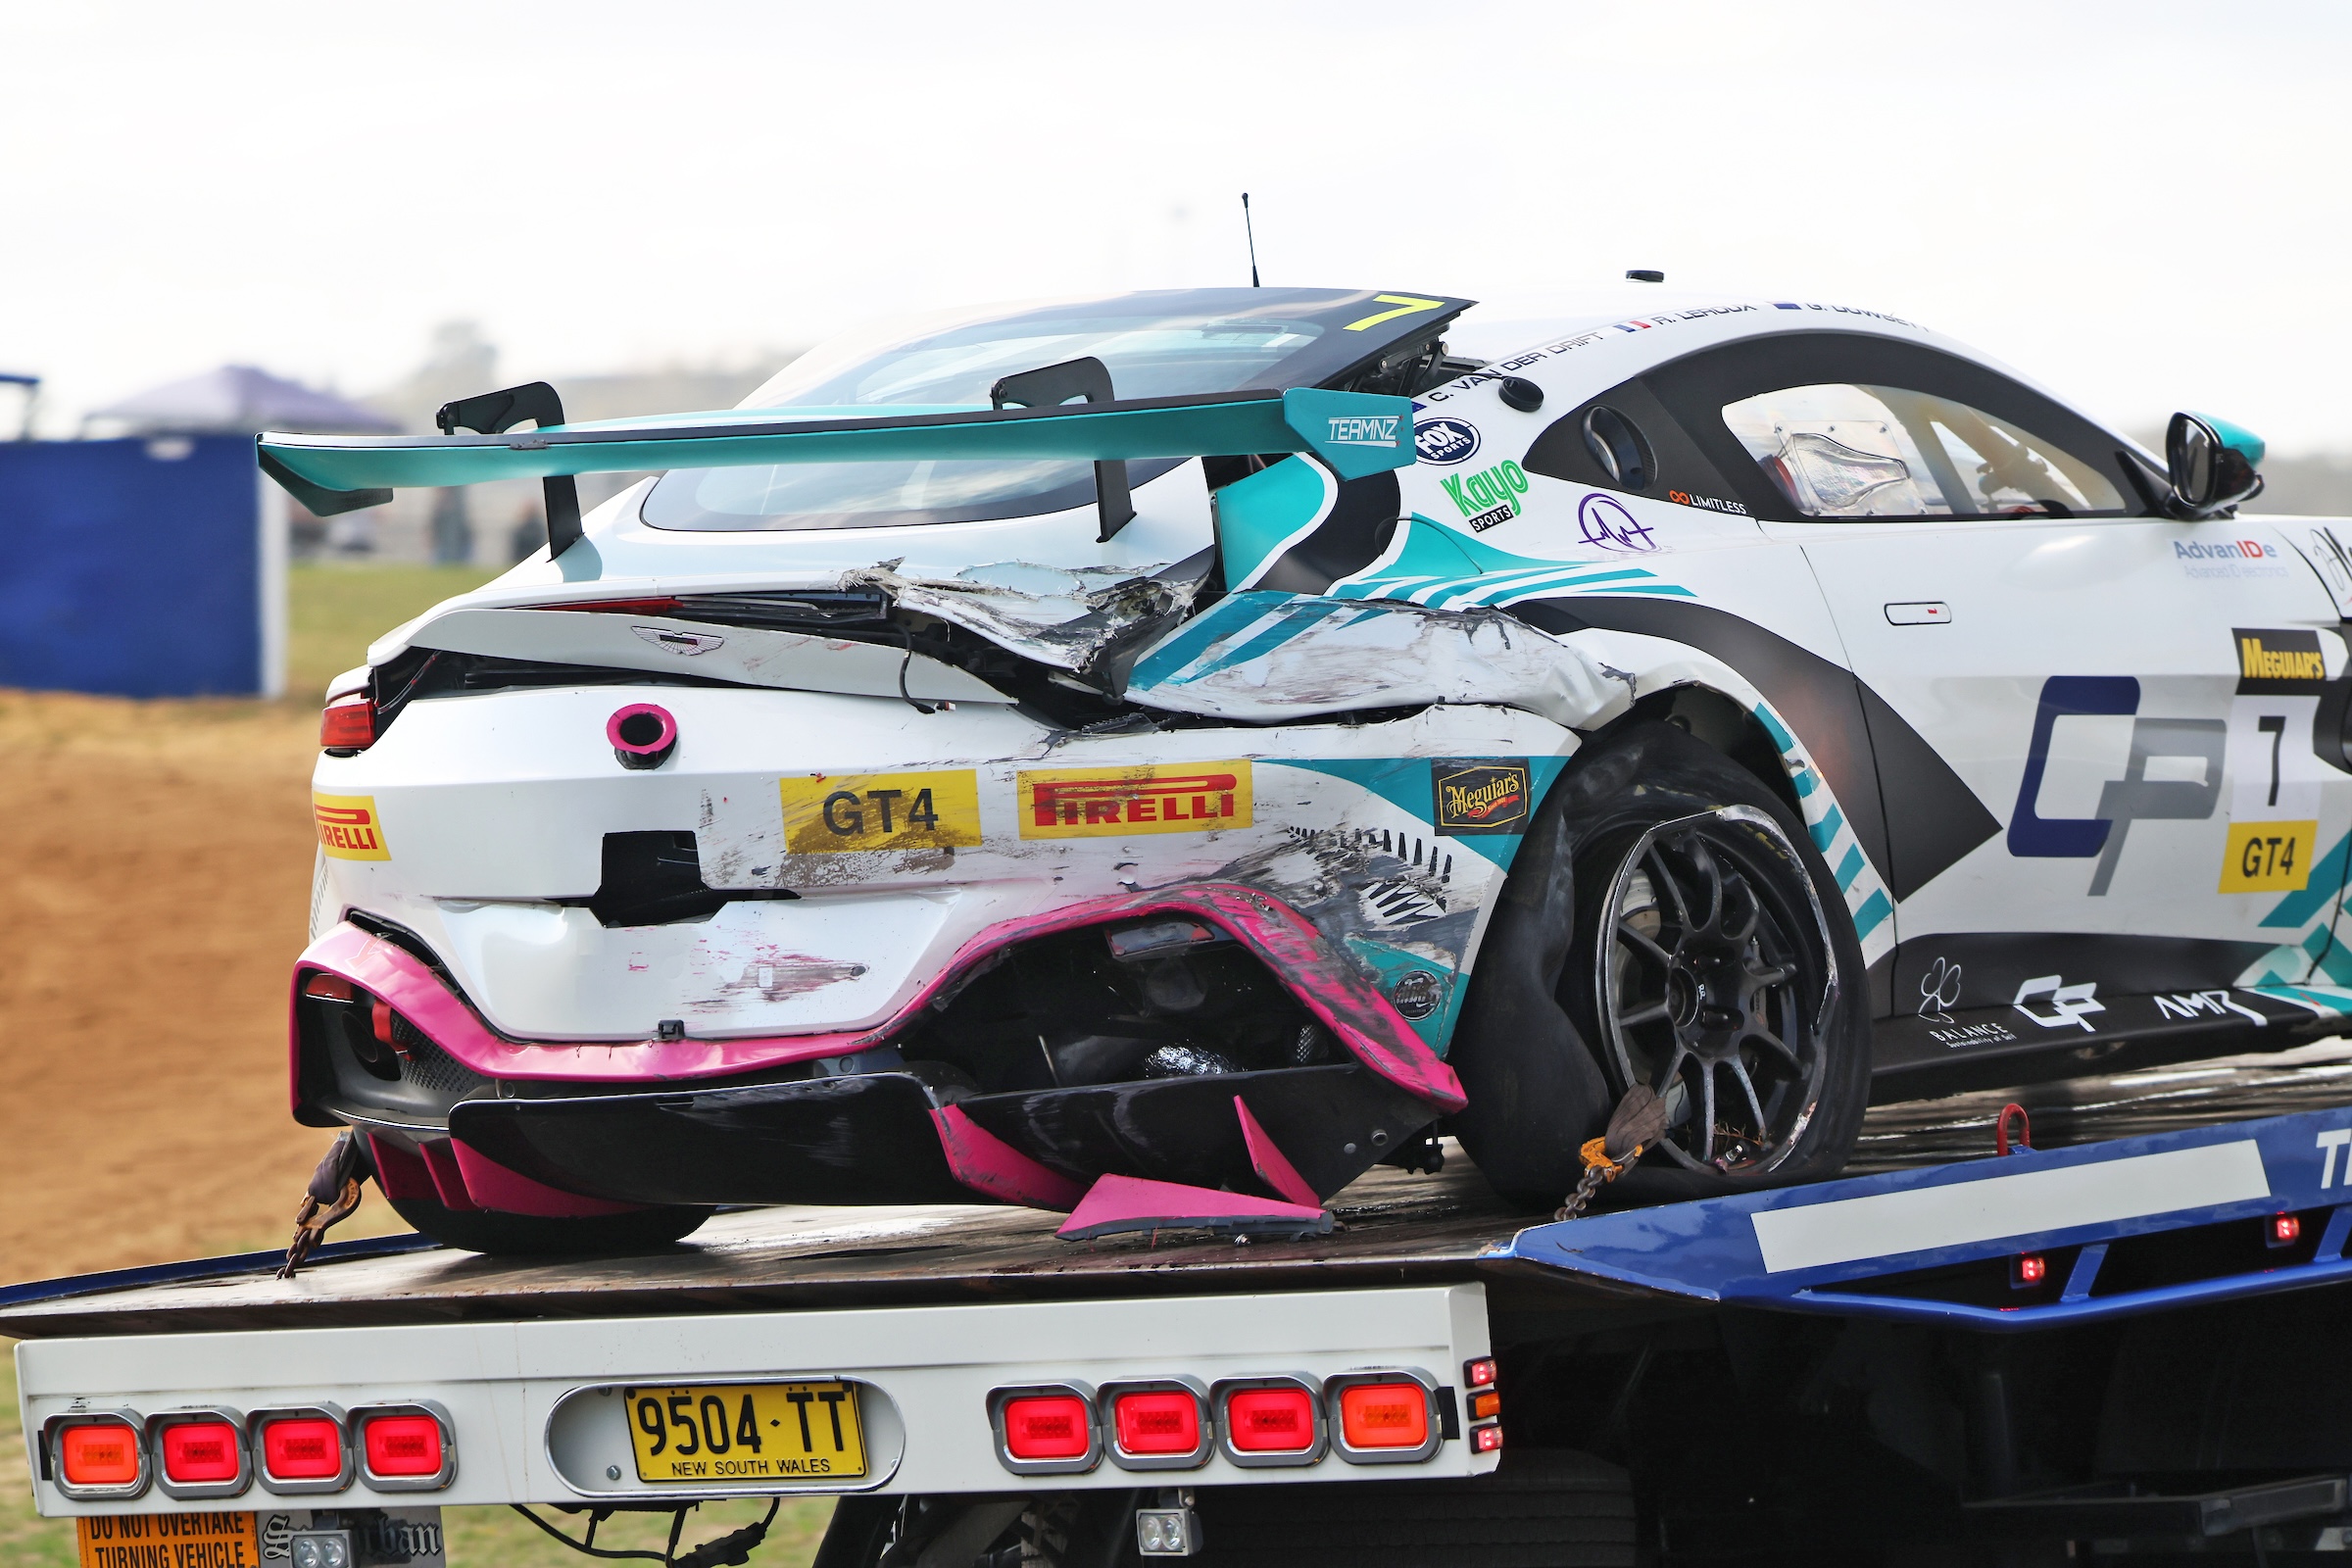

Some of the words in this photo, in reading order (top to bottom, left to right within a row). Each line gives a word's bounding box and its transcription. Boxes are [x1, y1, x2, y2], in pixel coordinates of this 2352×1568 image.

[1343, 294, 1446, 331] 7
[1428, 391, 1454, 403] C.
[1451, 368, 1503, 391] VAN
[1499, 352, 1547, 371] DER
[1545, 332, 1603, 355] DRIFT
[1328, 418, 1398, 441] TEAMNZ
[1415, 422, 1465, 455] FOX
[1430, 437, 1472, 460] SPORTS
[1440, 460, 1529, 516] Kayo
[1689, 493, 1747, 515] LIMITLESS
[1472, 507, 1512, 533] SPORTS
[2174, 540, 2278, 560] AdvanIDe
[2258, 715, 2286, 807] 7
[1033, 773, 1238, 827] PIRELLI
[1446, 772, 1520, 819] Meguiar's
[822, 788, 939, 837] GT4
[2242, 837, 2295, 878] GT4
[1929, 1022, 2008, 1042] BALANCE
[671, 1460, 707, 1476] NEW
[714, 1459, 768, 1475] SOUTH
[775, 1458, 831, 1473] WALES
[157, 1511, 245, 1538] OVERTAKE
[95, 1544, 170, 1568] TURNING
[173, 1542, 245, 1568] VEHICLE
